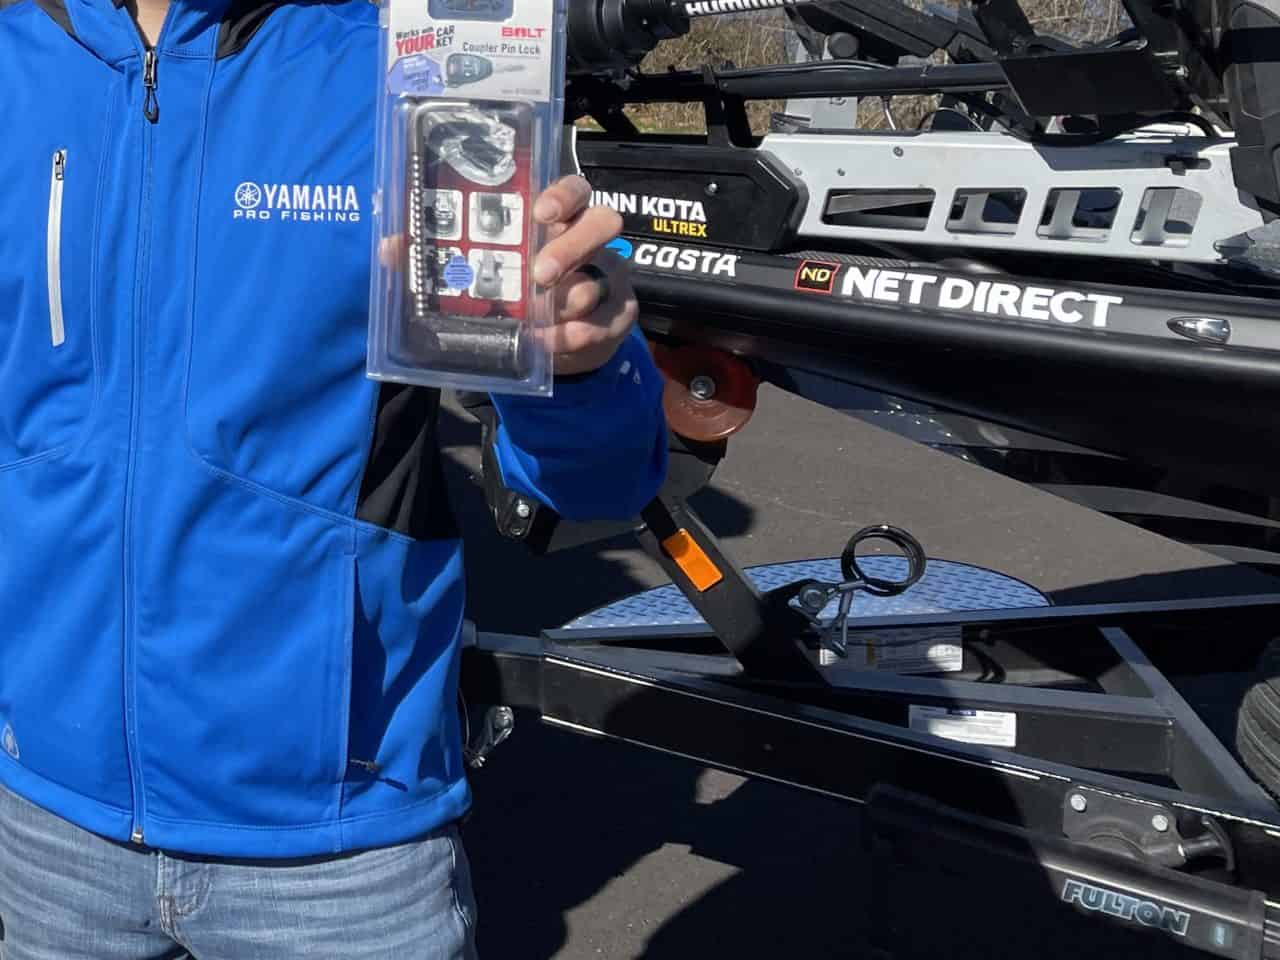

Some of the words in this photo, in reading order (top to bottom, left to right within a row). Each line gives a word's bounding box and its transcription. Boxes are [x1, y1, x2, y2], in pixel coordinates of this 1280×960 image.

[436, 25, 455, 37] CAR
[436, 36, 453, 48] KEY
[395, 33, 435, 56] YOUR
[501, 43, 517, 54] Pin
[263, 183, 360, 211] YAMAHA
[588, 189, 638, 214] INN
[641, 195, 708, 223] KOTA
[233, 209, 270, 220] PRO
[281, 209, 361, 223] FISHING
[653, 217, 708, 238] ULTREX
[634, 243, 738, 278] COSTA
[801, 266, 831, 283] ND
[841, 266, 938, 305] NET
[938, 277, 1123, 328] DIRECT
[1061, 879, 1192, 937] FULTON
